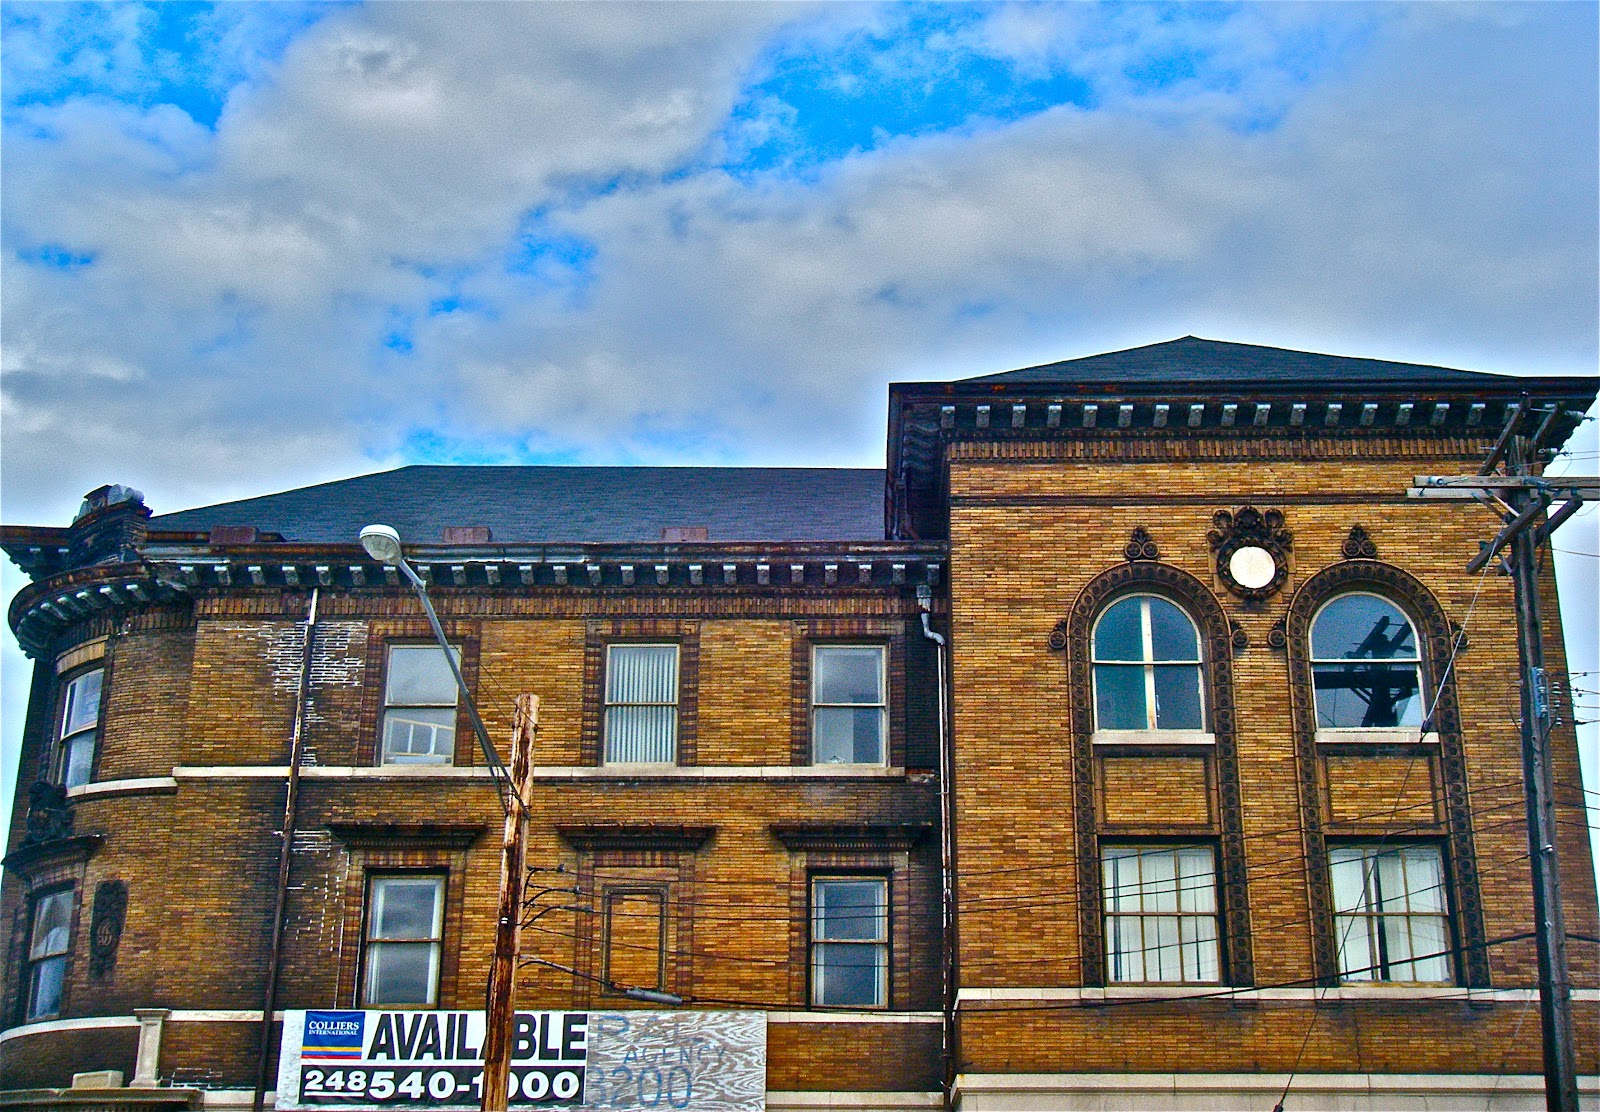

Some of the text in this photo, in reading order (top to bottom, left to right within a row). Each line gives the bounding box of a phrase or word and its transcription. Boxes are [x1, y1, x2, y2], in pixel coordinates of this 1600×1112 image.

[309, 1020, 359, 1030] COLLIERS
[367, 1013, 587, 1060] AVAILBLE
[305, 1069, 366, 1091] 248
